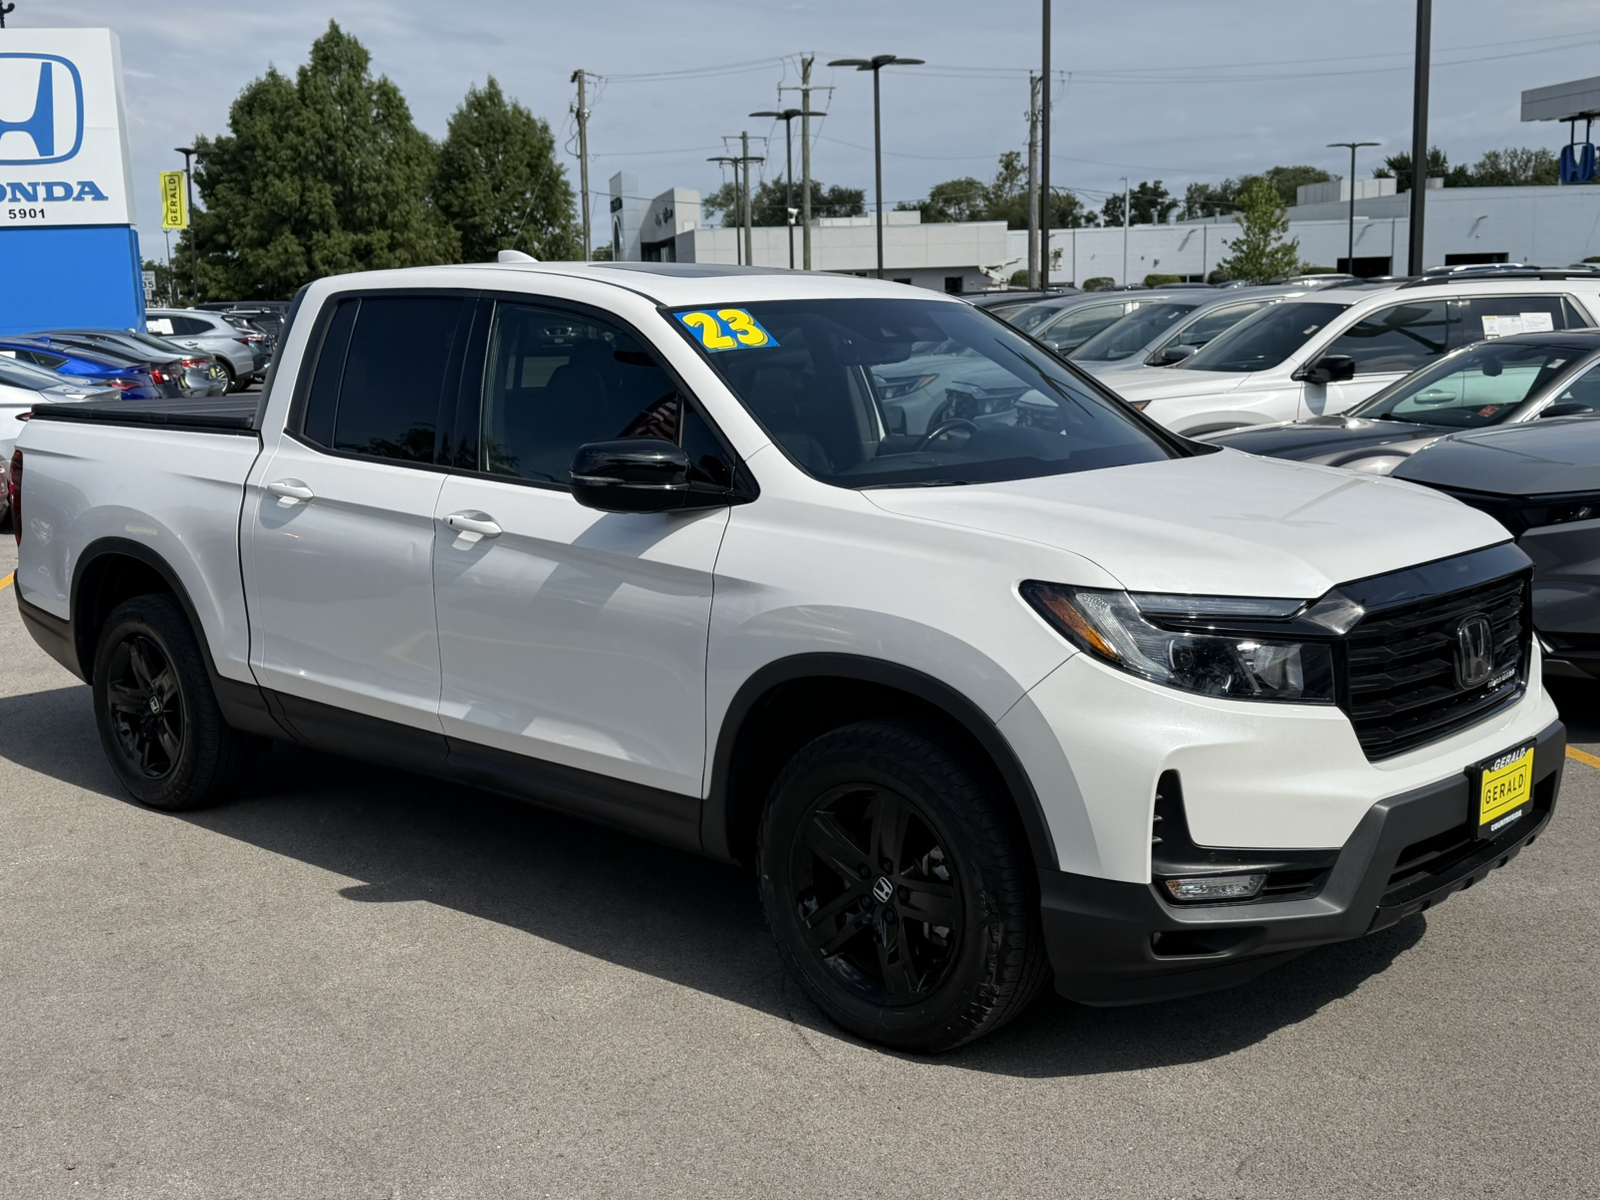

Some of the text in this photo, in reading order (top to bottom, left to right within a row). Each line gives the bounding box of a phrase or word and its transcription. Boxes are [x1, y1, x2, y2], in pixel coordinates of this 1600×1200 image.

[0, 181, 109, 202] NDA
[168, 177, 178, 222] GERALD
[8, 208, 45, 219] 5901
[682, 309, 769, 350] 23
[1494, 747, 1526, 771] GERALD
[1485, 774, 1524, 804] GERALD
